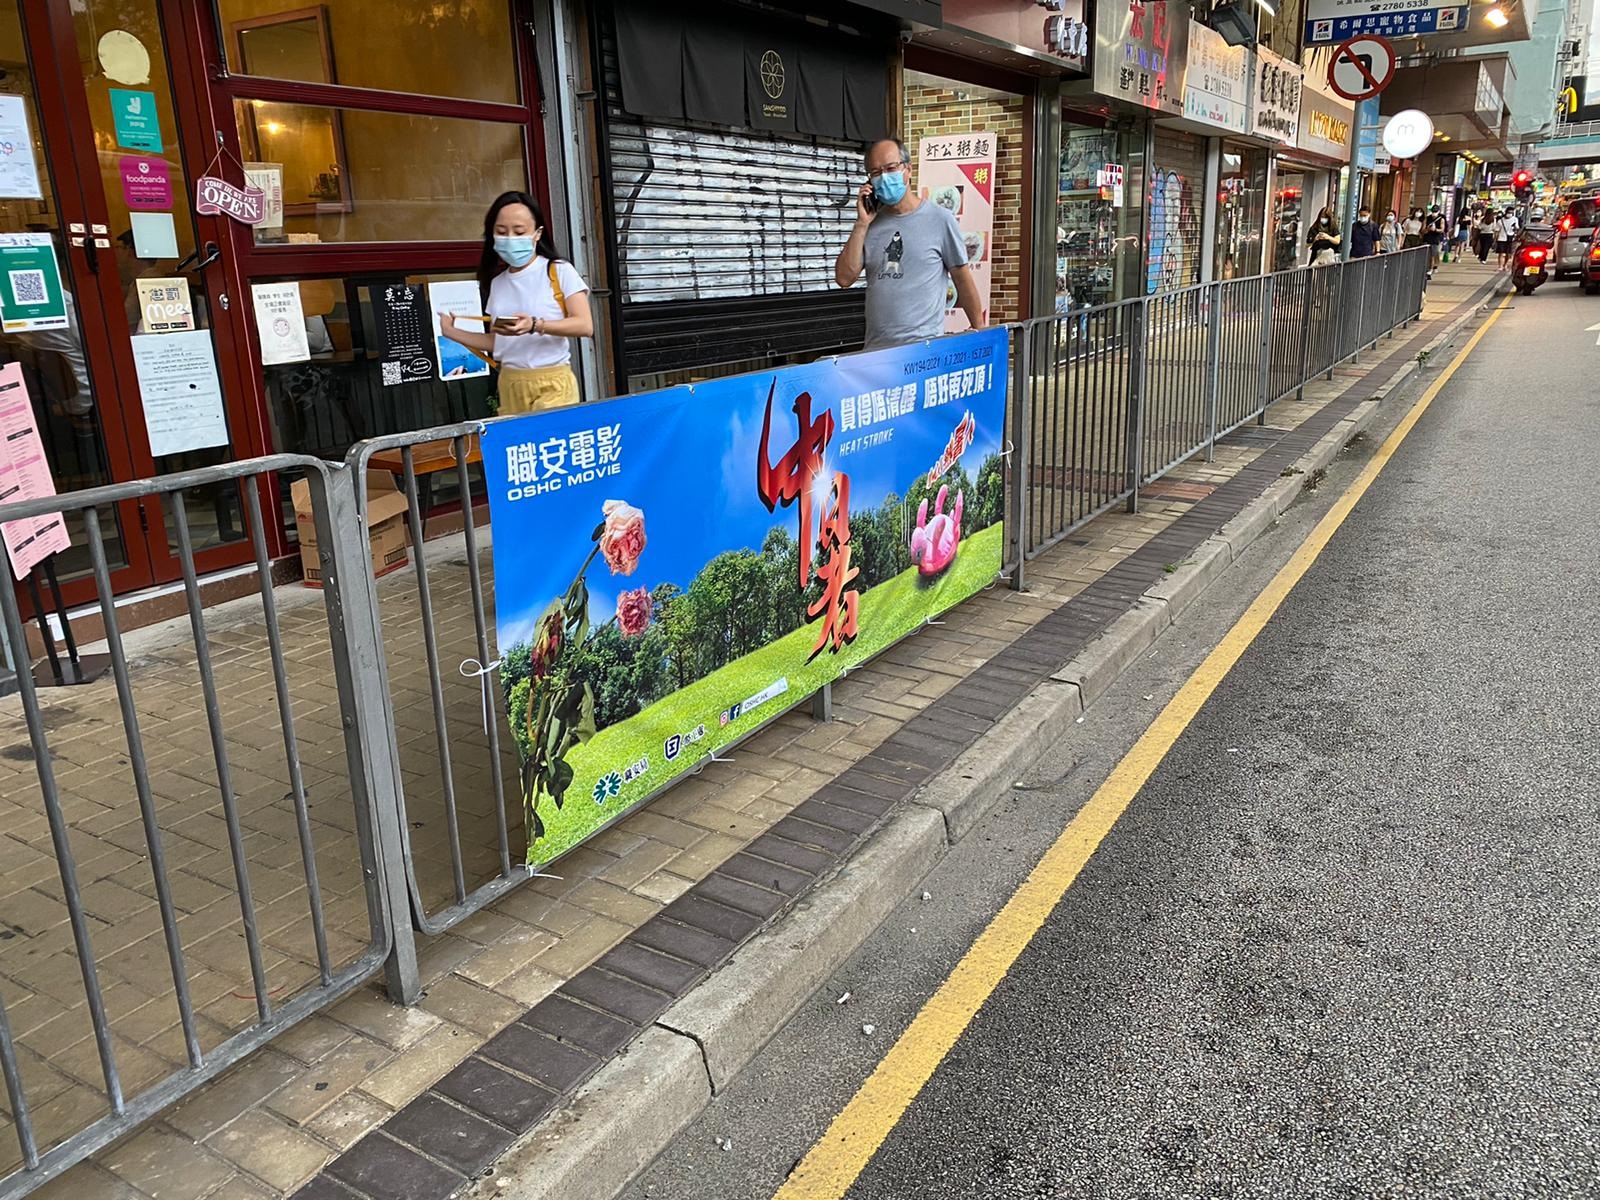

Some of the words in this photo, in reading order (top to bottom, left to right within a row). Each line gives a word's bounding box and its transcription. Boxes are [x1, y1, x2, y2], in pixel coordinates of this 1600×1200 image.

[1383, 2, 1404, 10] 2780
[926, 139, 990, 157] 虾公粥麵
[126, 175, 166, 184] foodpanda
[974, 168, 988, 184] 粥
[204, 187, 258, 218] OPEN
[841, 382, 917, 433] 覺得唔清醒
[506, 423, 622, 486] 職安電影
[839, 437, 862, 457] HEAT
[863, 428, 895, 450] STROKE
[507, 478, 562, 501] OSHC
[567, 463, 621, 487] MOVIE
